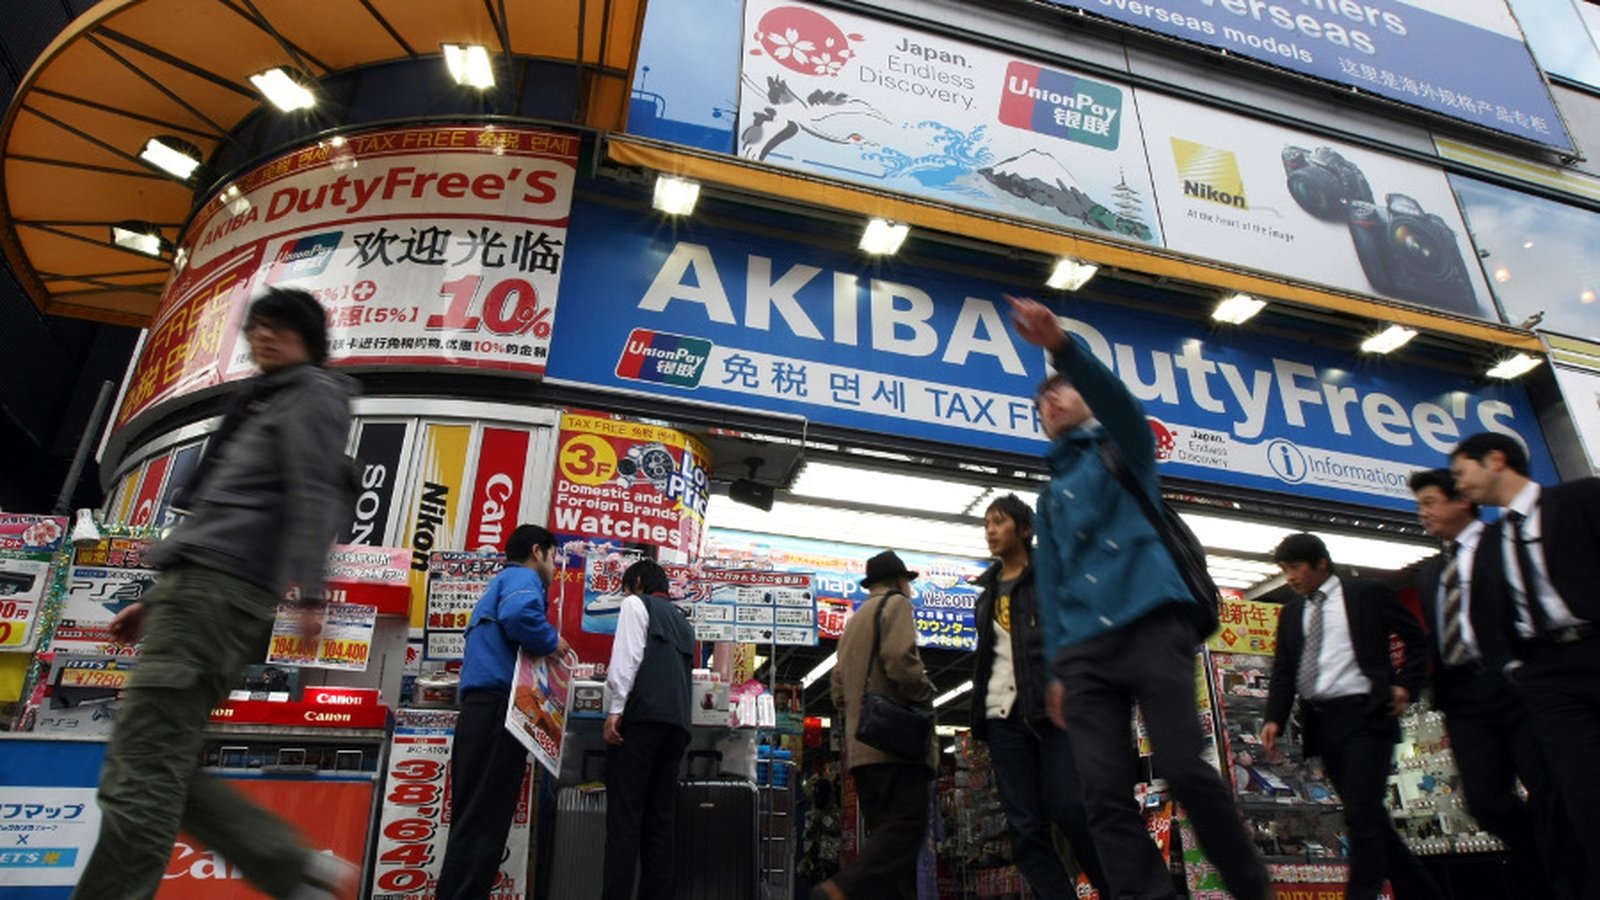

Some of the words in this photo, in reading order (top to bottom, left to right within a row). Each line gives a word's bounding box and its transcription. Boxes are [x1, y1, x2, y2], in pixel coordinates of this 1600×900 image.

[896, 37, 972, 69] Japan.
[1223, 25, 1313, 64] models
[859, 66, 977, 110] Discovery.
[888, 55, 975, 90] Endless
[1009, 76, 1118, 125] UnionPay
[1053, 107, 1110, 137] 银联
[356, 135, 397, 153] TAX
[402, 131, 467, 148] FREE
[530, 136, 571, 155] 면세
[201, 206, 259, 250] AKIBA
[265, 167, 558, 222] DutyFree'S
[1184, 180, 1246, 209] Nikon
[345, 226, 563, 274] 欢迎光临
[1268, 227, 1295, 242] image
[425, 274, 552, 339] 10%
[637, 242, 1027, 377] AKIBA
[629, 341, 705, 370] UnionPay
[721, 354, 808, 397] 免税
[829, 371, 906, 413] 면세
[567, 417, 593, 429] TAX
[594, 421, 626, 435] FREE
[924, 386, 997, 428] TAX
[1008, 401, 1040, 433] FR
[682, 450, 705, 486] Lo
[1308, 455, 1408, 488] Information
[350, 464, 387, 546] SON
[556, 493, 620, 512] Foreign
[558, 480, 631, 501] Domestic
[634, 488, 663, 505] and
[669, 474, 707, 519] Pric
[410, 481, 449, 572] Nikon
[475, 473, 514, 553] Can
[555, 507, 682, 546] Watches
[69, 581, 142, 598] PS3
[922, 590, 977, 608] Welcom
[316, 692, 362, 704] Canon
[304, 711, 351, 722] Canon
[0, 803, 85, 819] フマップ
[1318, 891, 1345, 900] FRE
